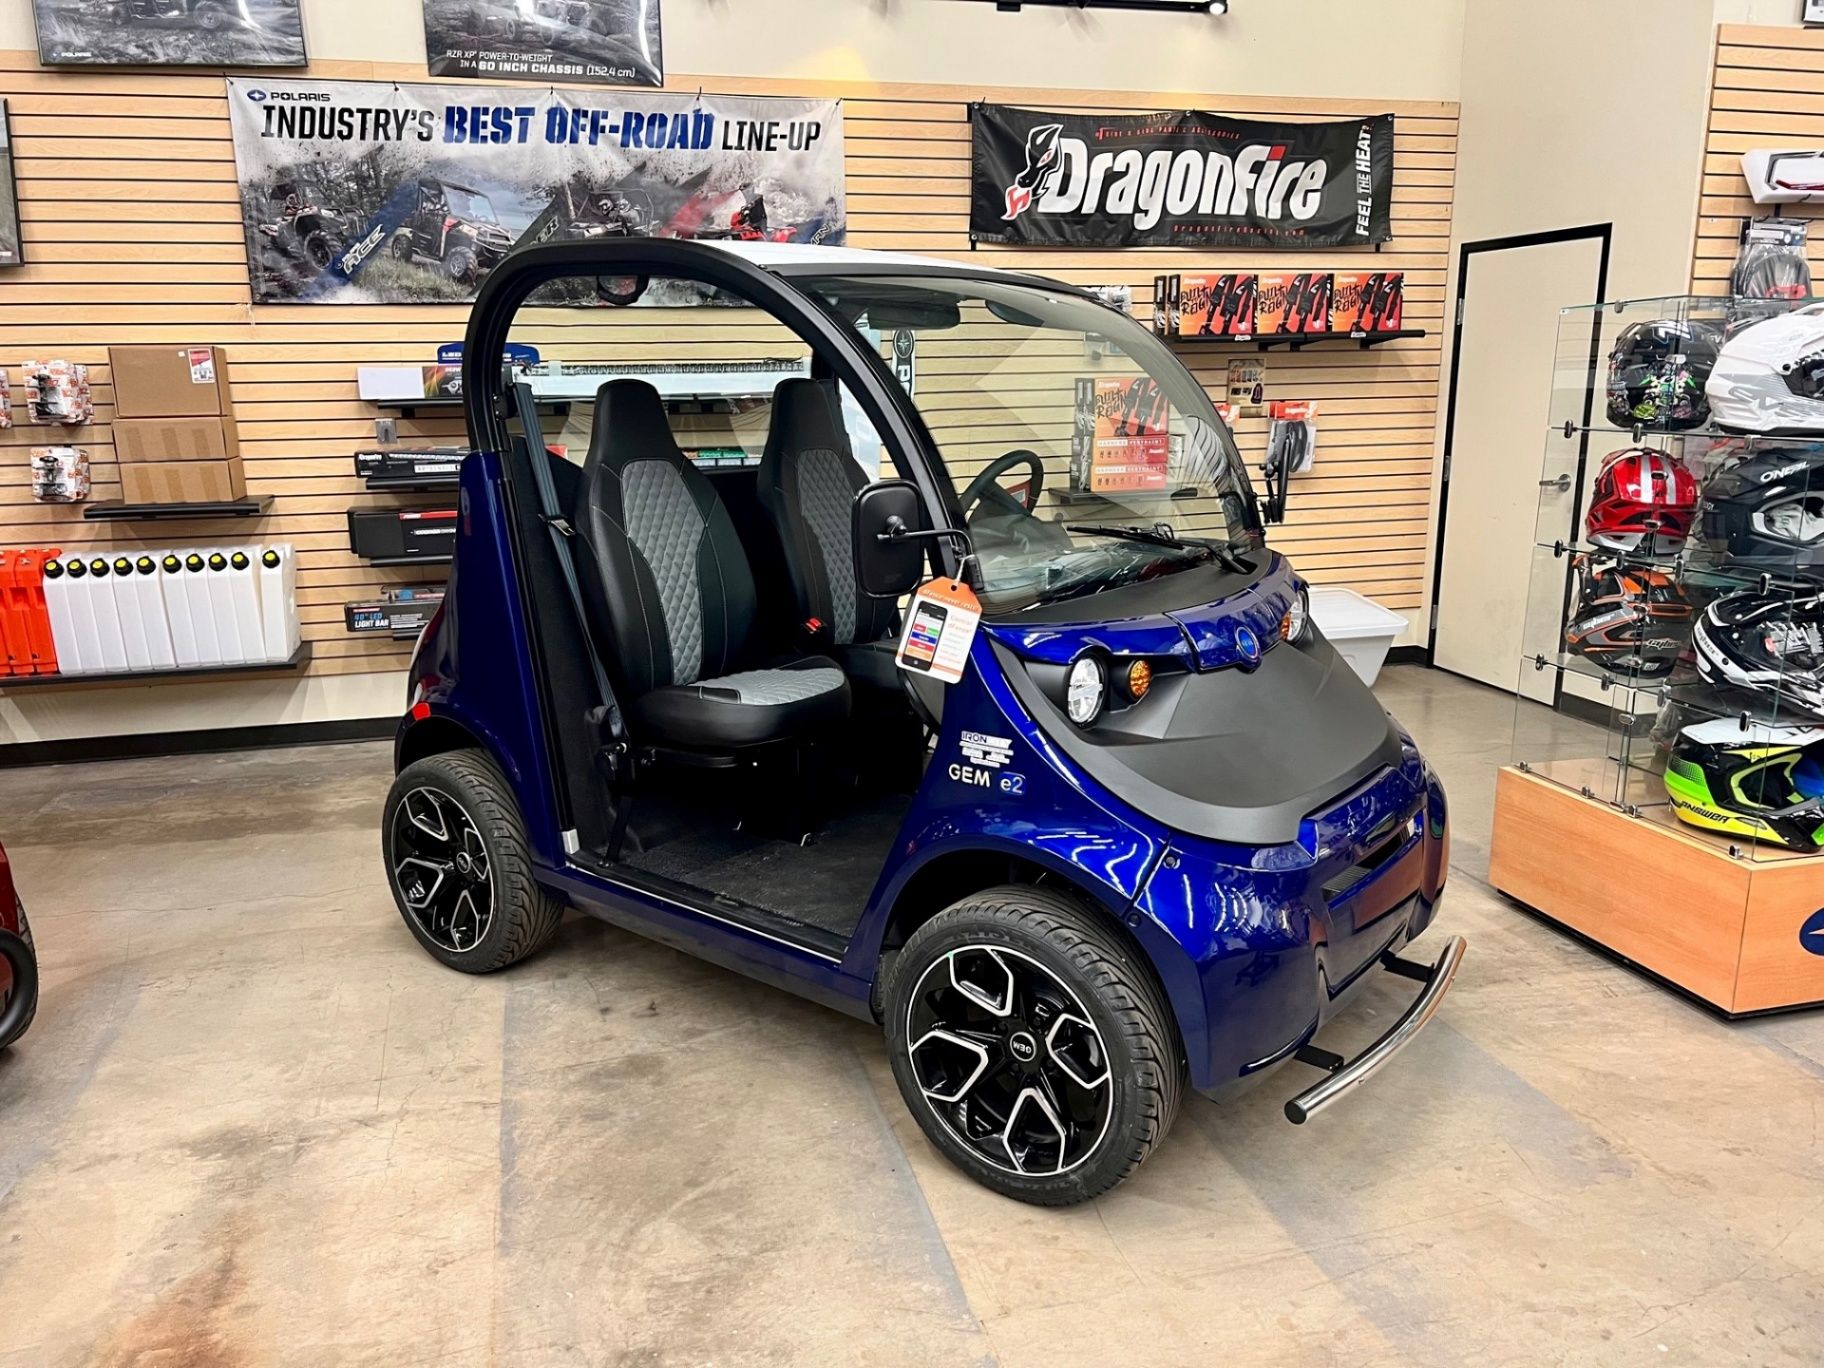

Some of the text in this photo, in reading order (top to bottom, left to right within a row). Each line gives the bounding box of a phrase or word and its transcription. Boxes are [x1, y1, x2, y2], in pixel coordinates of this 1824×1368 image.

[446, 50, 463, 59] RZR
[479, 52, 553, 62] POWER-TO-WEIGHT
[460, 59, 636, 78] IN A 60 INCH CHASSIS (152.4 cm)
[270, 91, 331, 102] POLARIS
[261, 105, 821, 151] INDUSTRY'S BEST OFF-ROAD LINE-UP
[1356, 173, 1372, 195] THE
[1355, 197, 1373, 237] FEEL
[354, 620, 375, 628] LIGHT
[375, 619, 390, 627] BAR
[961, 732, 987, 743] IRON
[948, 763, 1023, 794] GEM e2
